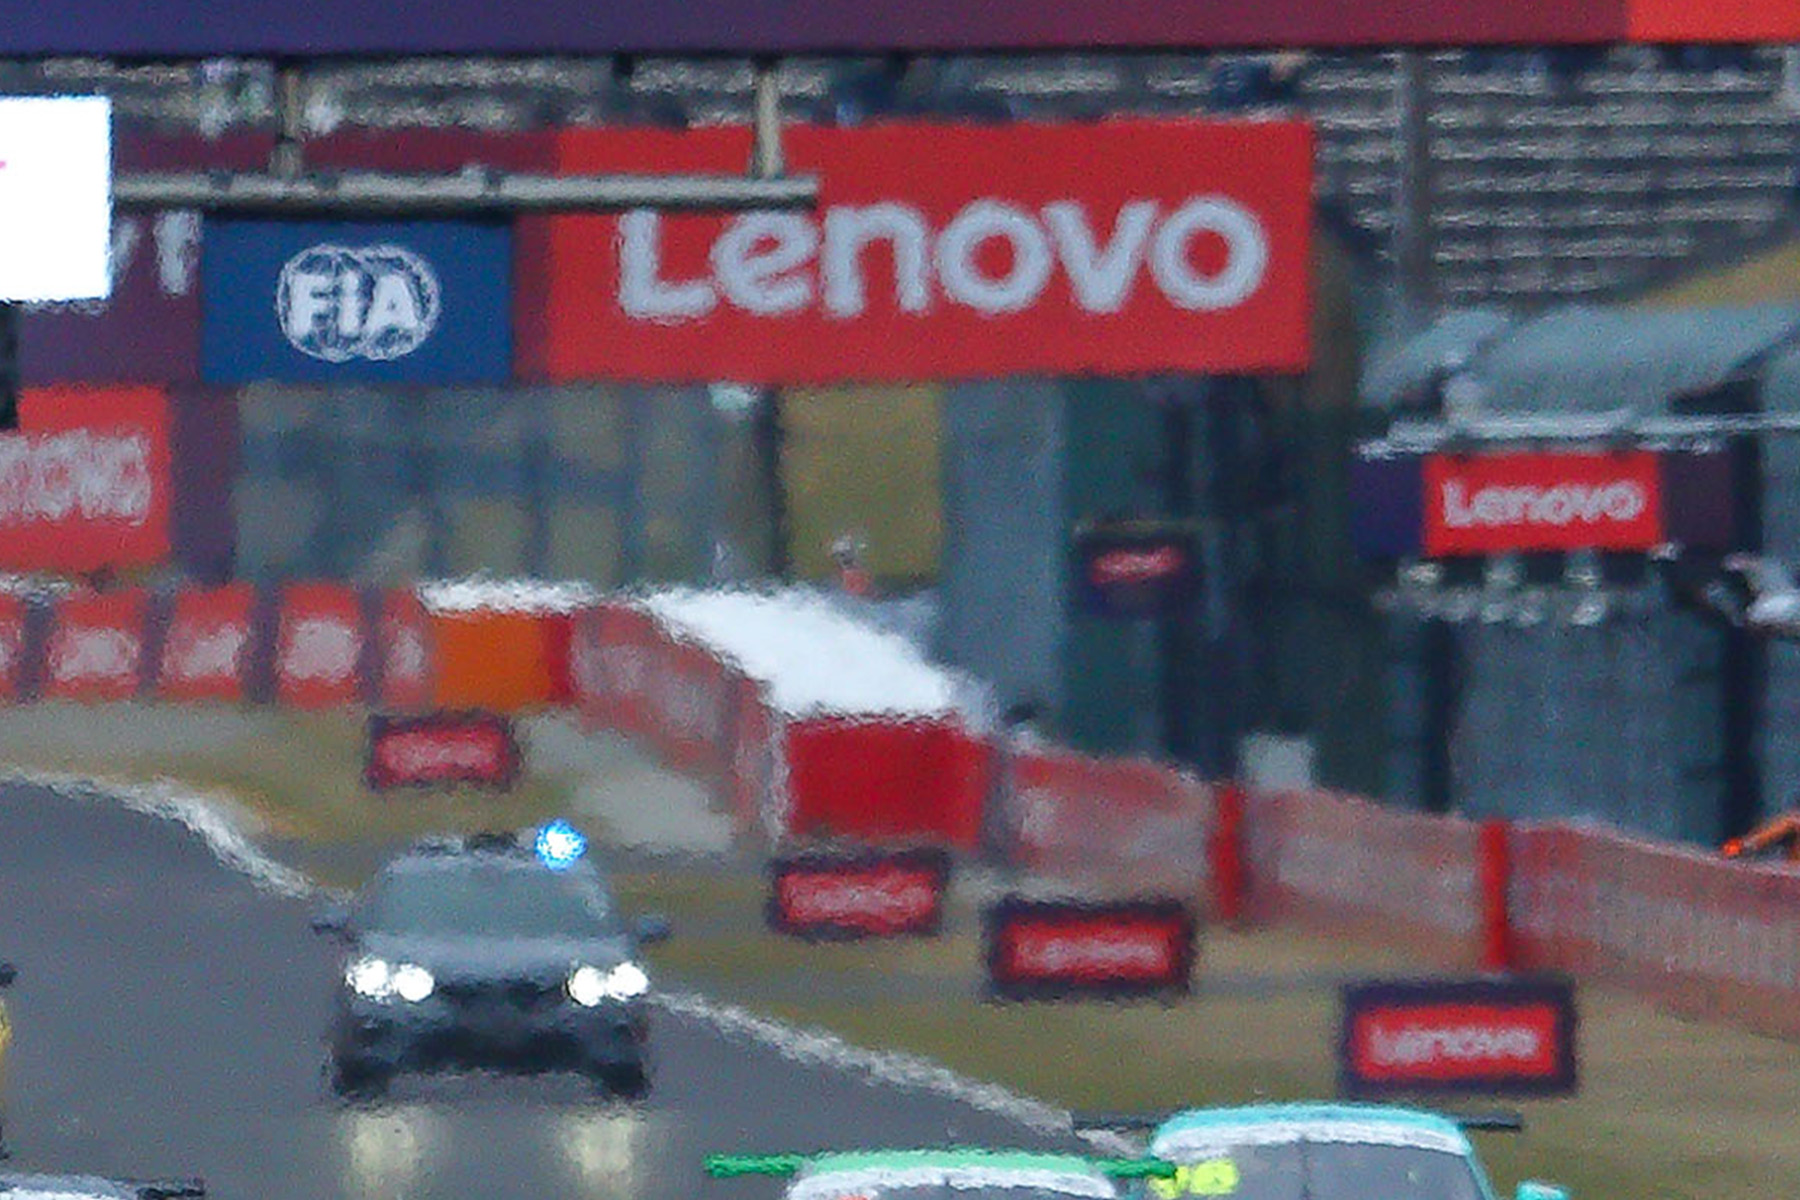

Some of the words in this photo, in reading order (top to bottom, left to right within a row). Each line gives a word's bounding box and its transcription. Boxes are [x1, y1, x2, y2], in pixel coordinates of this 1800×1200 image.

[616, 196, 1270, 322] Lenovo
[289, 271, 422, 337] FIA
[1441, 480, 1646, 527] Lenovo
